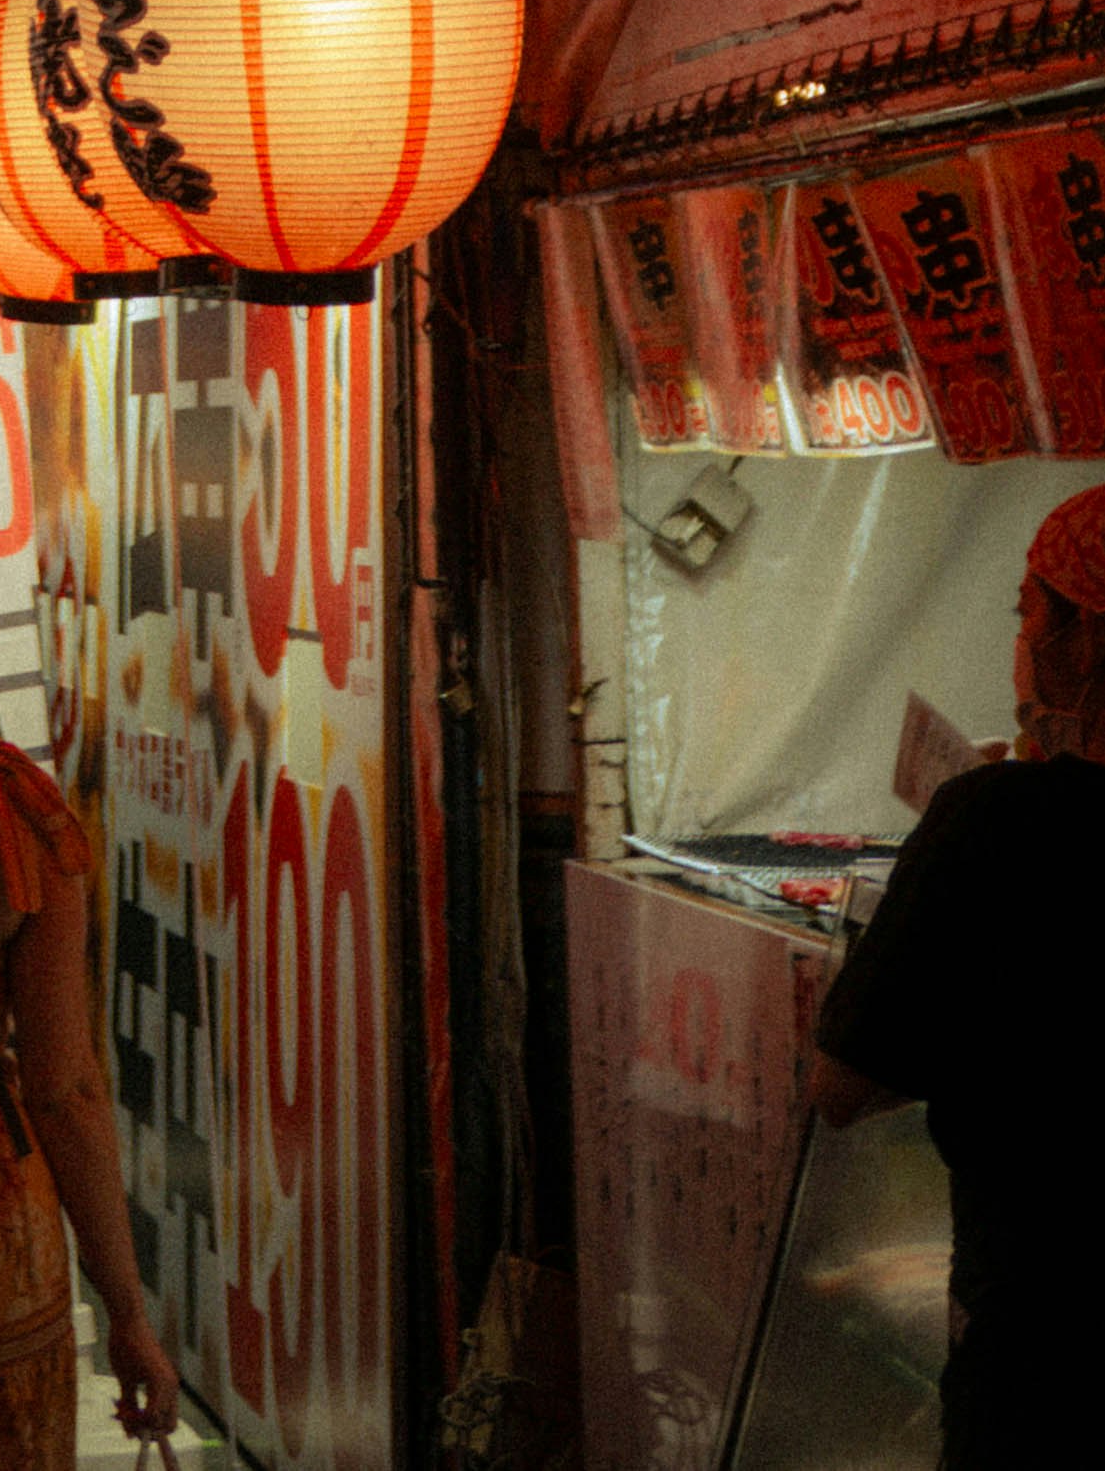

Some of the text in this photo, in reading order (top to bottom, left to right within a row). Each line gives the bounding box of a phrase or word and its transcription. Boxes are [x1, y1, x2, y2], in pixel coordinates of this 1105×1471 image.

[812, 197, 881, 305] 串
[900, 191, 989, 308] 串
[834, 372, 925, 444] 400
